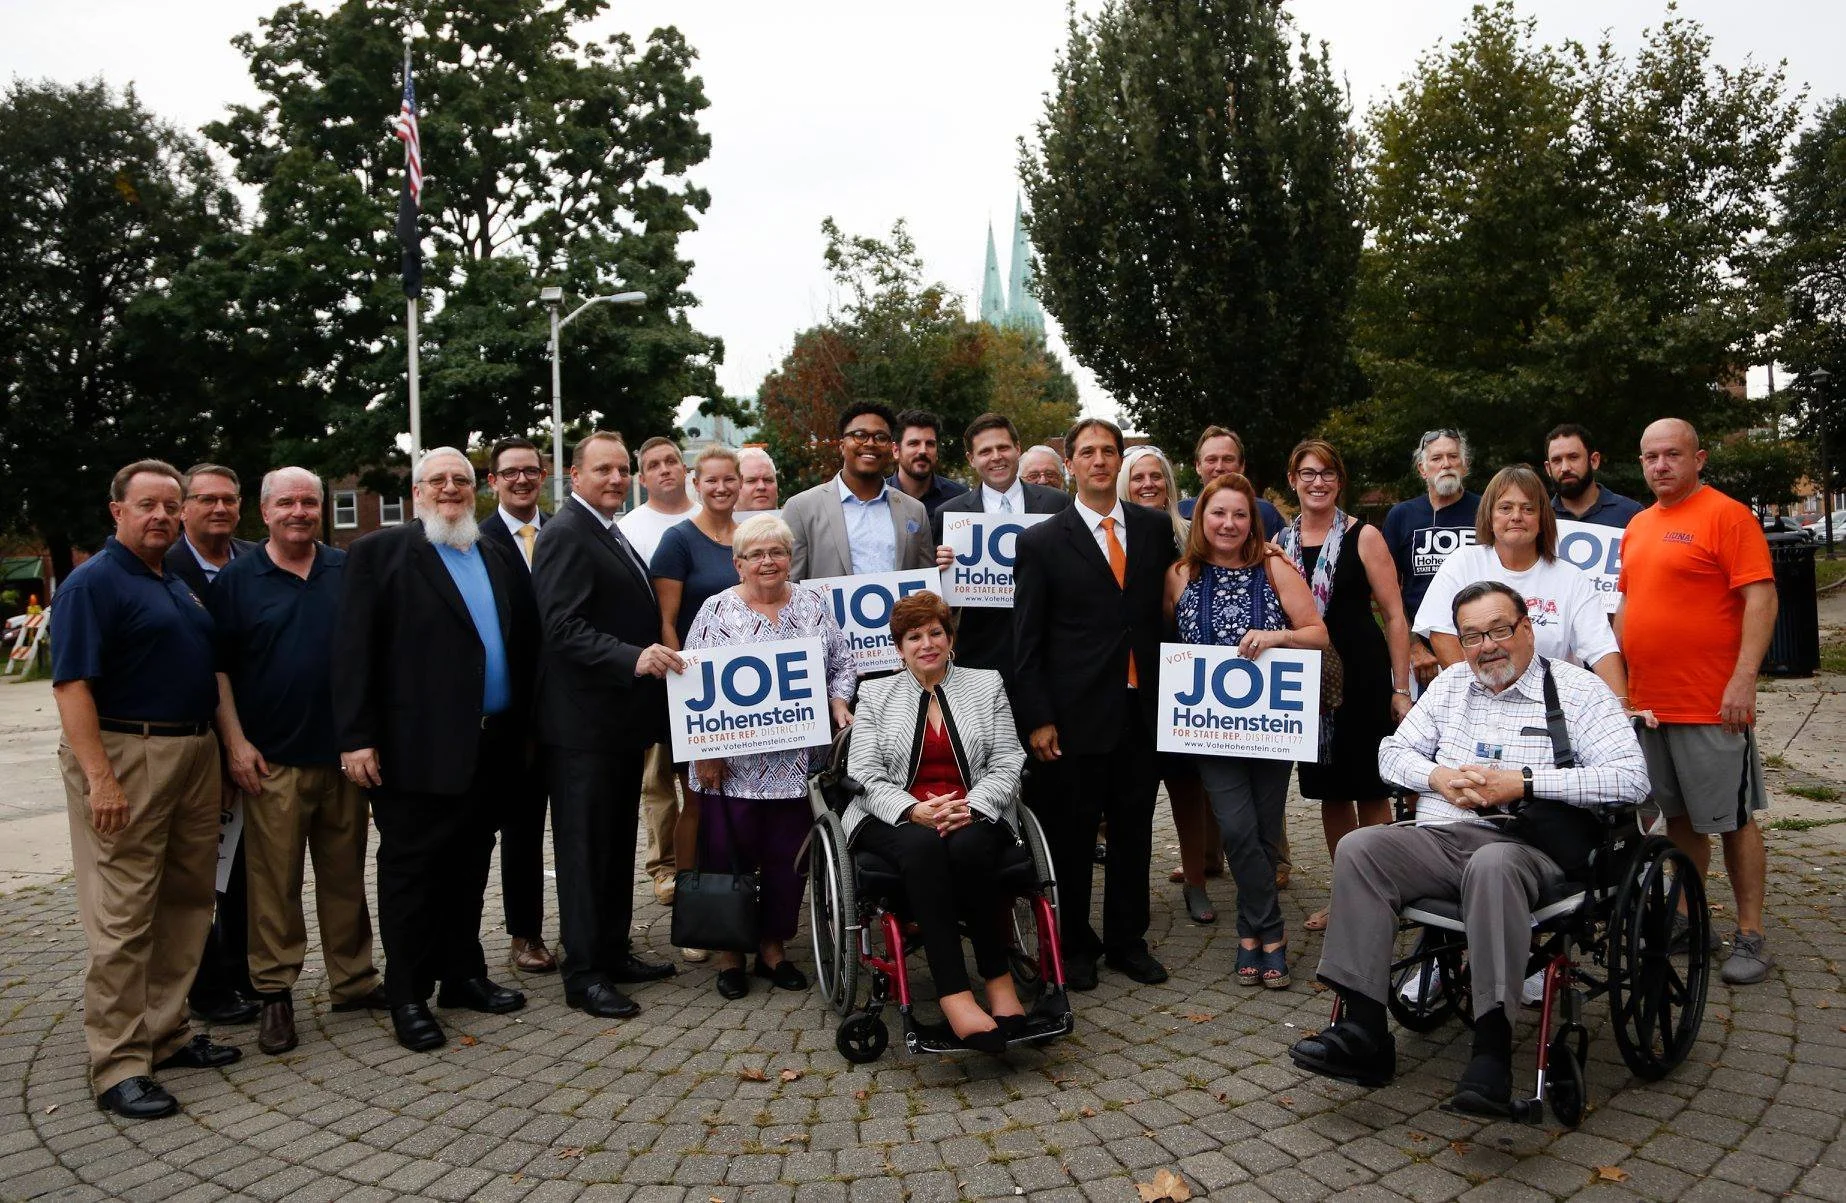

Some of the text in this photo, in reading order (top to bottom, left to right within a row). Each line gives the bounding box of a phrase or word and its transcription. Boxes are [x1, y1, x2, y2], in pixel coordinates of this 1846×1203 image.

[948, 518, 971, 531] VOTE
[955, 523, 1026, 567] JO
[1559, 531, 1622, 574] OE
[973, 586, 996, 594] STATE
[682, 655, 699, 669] OTE
[1166, 651, 1193, 664] VOTE
[685, 651, 812, 711] JOE
[1174, 658, 1303, 711] JOE
[686, 702, 814, 734] Hohenstein
[1173, 707, 1303, 734] Hohenstein
[688, 734, 706, 745] FOR
[709, 731, 735, 743] STATE
[761, 723, 798, 737] DISTRICT
[802, 721, 816, 732] 177
[1172, 728, 1190, 738] FOR
[1193, 729, 1219, 740] STATE
[1245, 733, 1285, 745] DISTRICT
[701, 735, 805, 752] www.VoteHohenstein.com
[1184, 740, 1290, 754] www.VoteHohenstein.com
